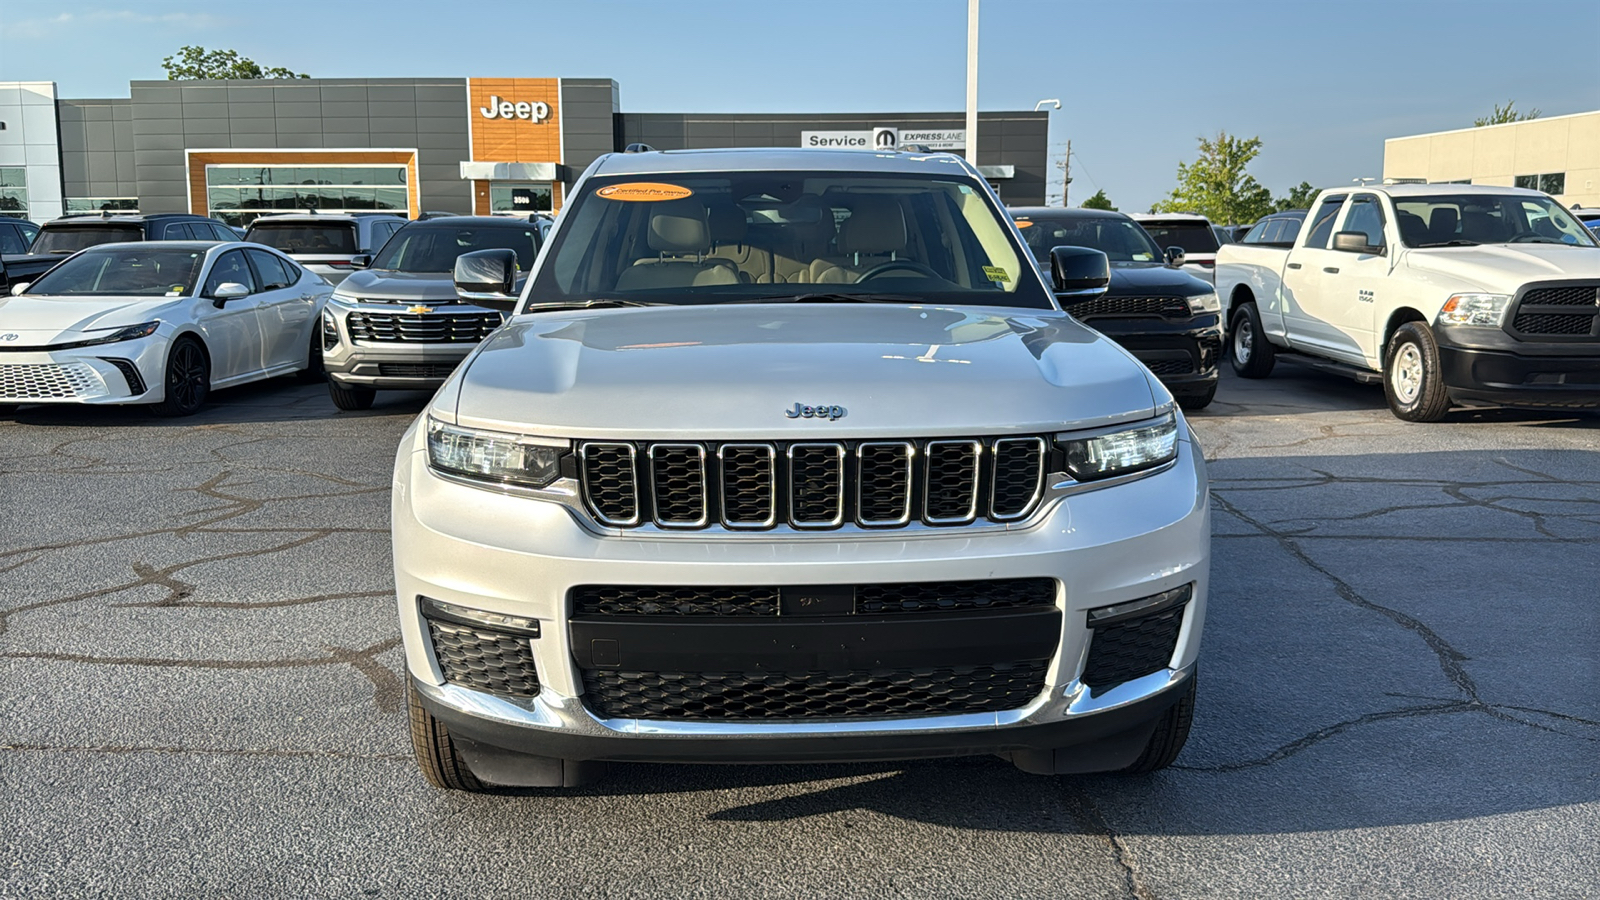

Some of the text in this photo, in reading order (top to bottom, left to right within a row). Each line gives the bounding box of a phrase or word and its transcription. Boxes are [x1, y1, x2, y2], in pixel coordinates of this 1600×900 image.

[480, 95, 548, 123] Jeep
[809, 135, 866, 146] Service
[904, 132, 962, 140] EXPRESSLANE
[785, 402, 843, 421] Jeep
